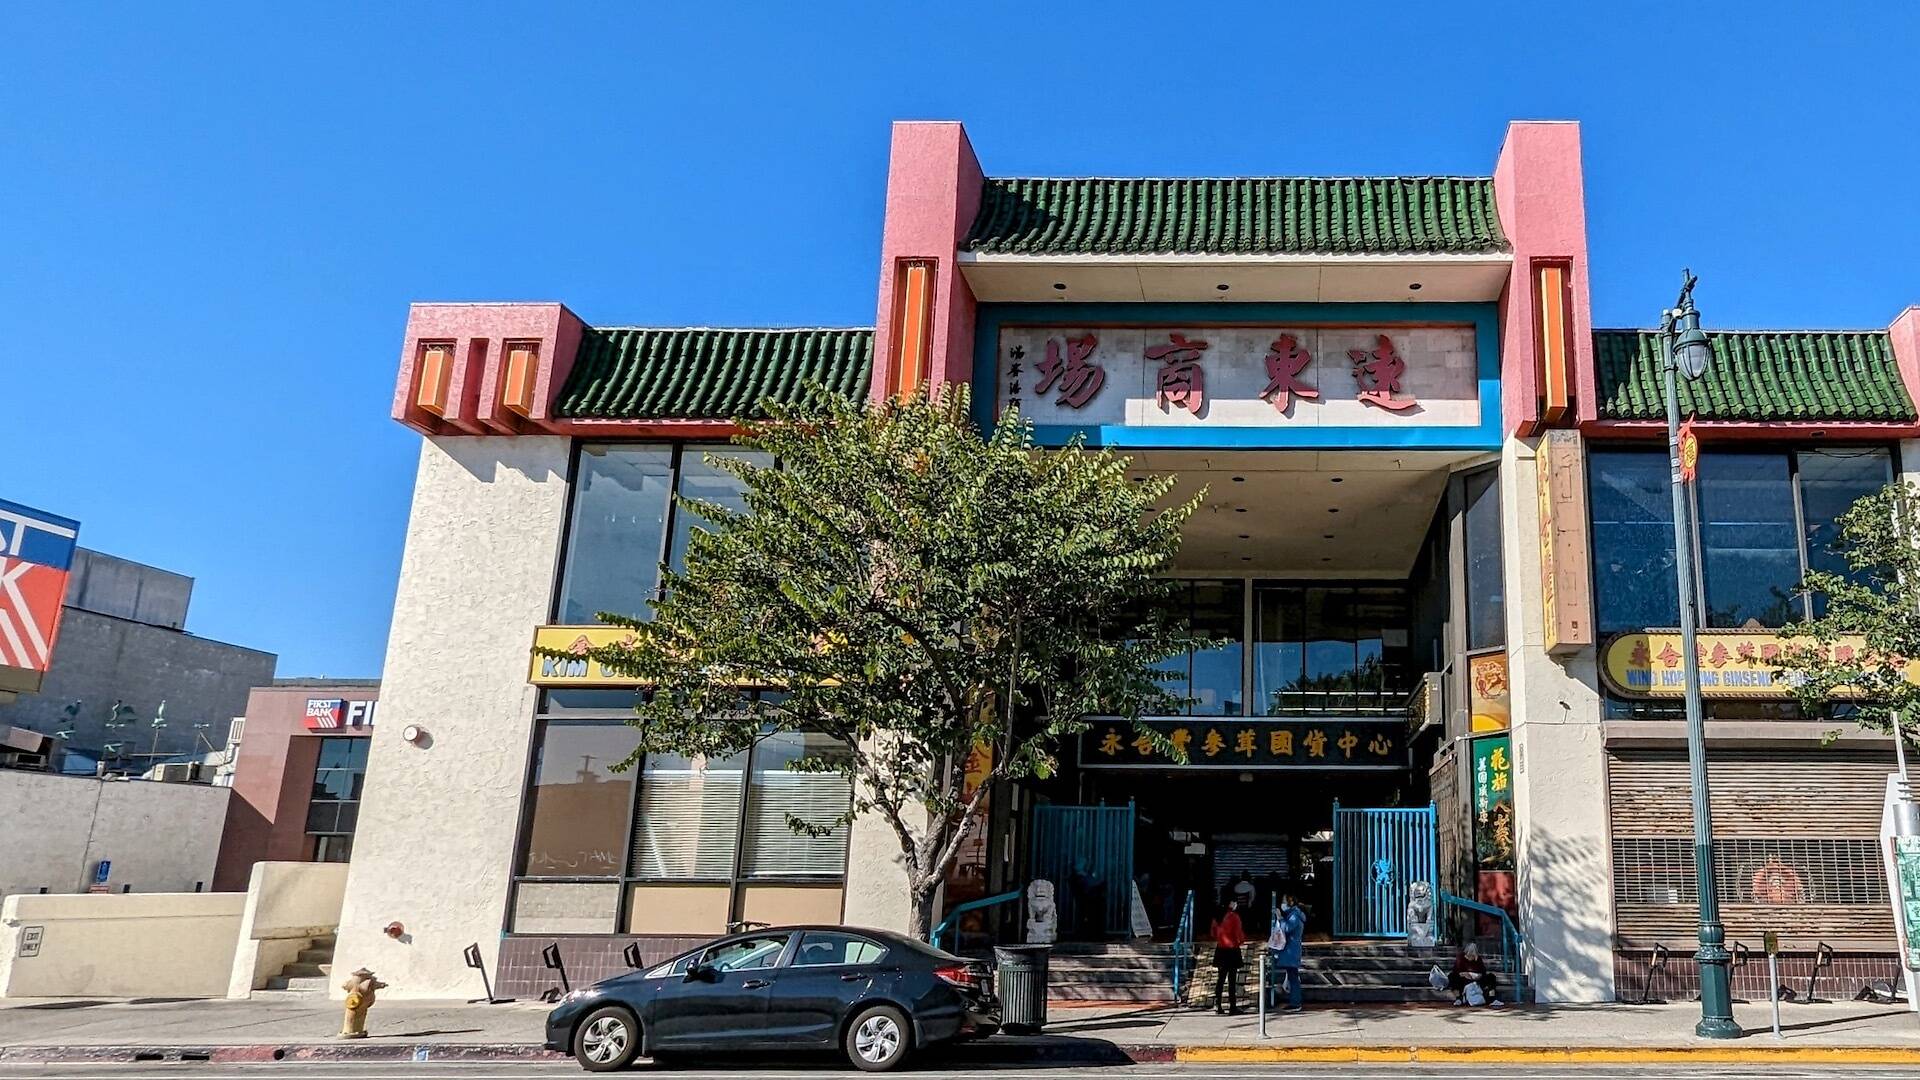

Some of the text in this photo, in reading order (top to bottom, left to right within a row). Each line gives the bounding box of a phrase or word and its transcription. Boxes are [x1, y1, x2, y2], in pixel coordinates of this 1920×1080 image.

[0, 509, 76, 556] T
[1626, 669, 1658, 686] WING
[308, 700, 337, 708] FIRST
